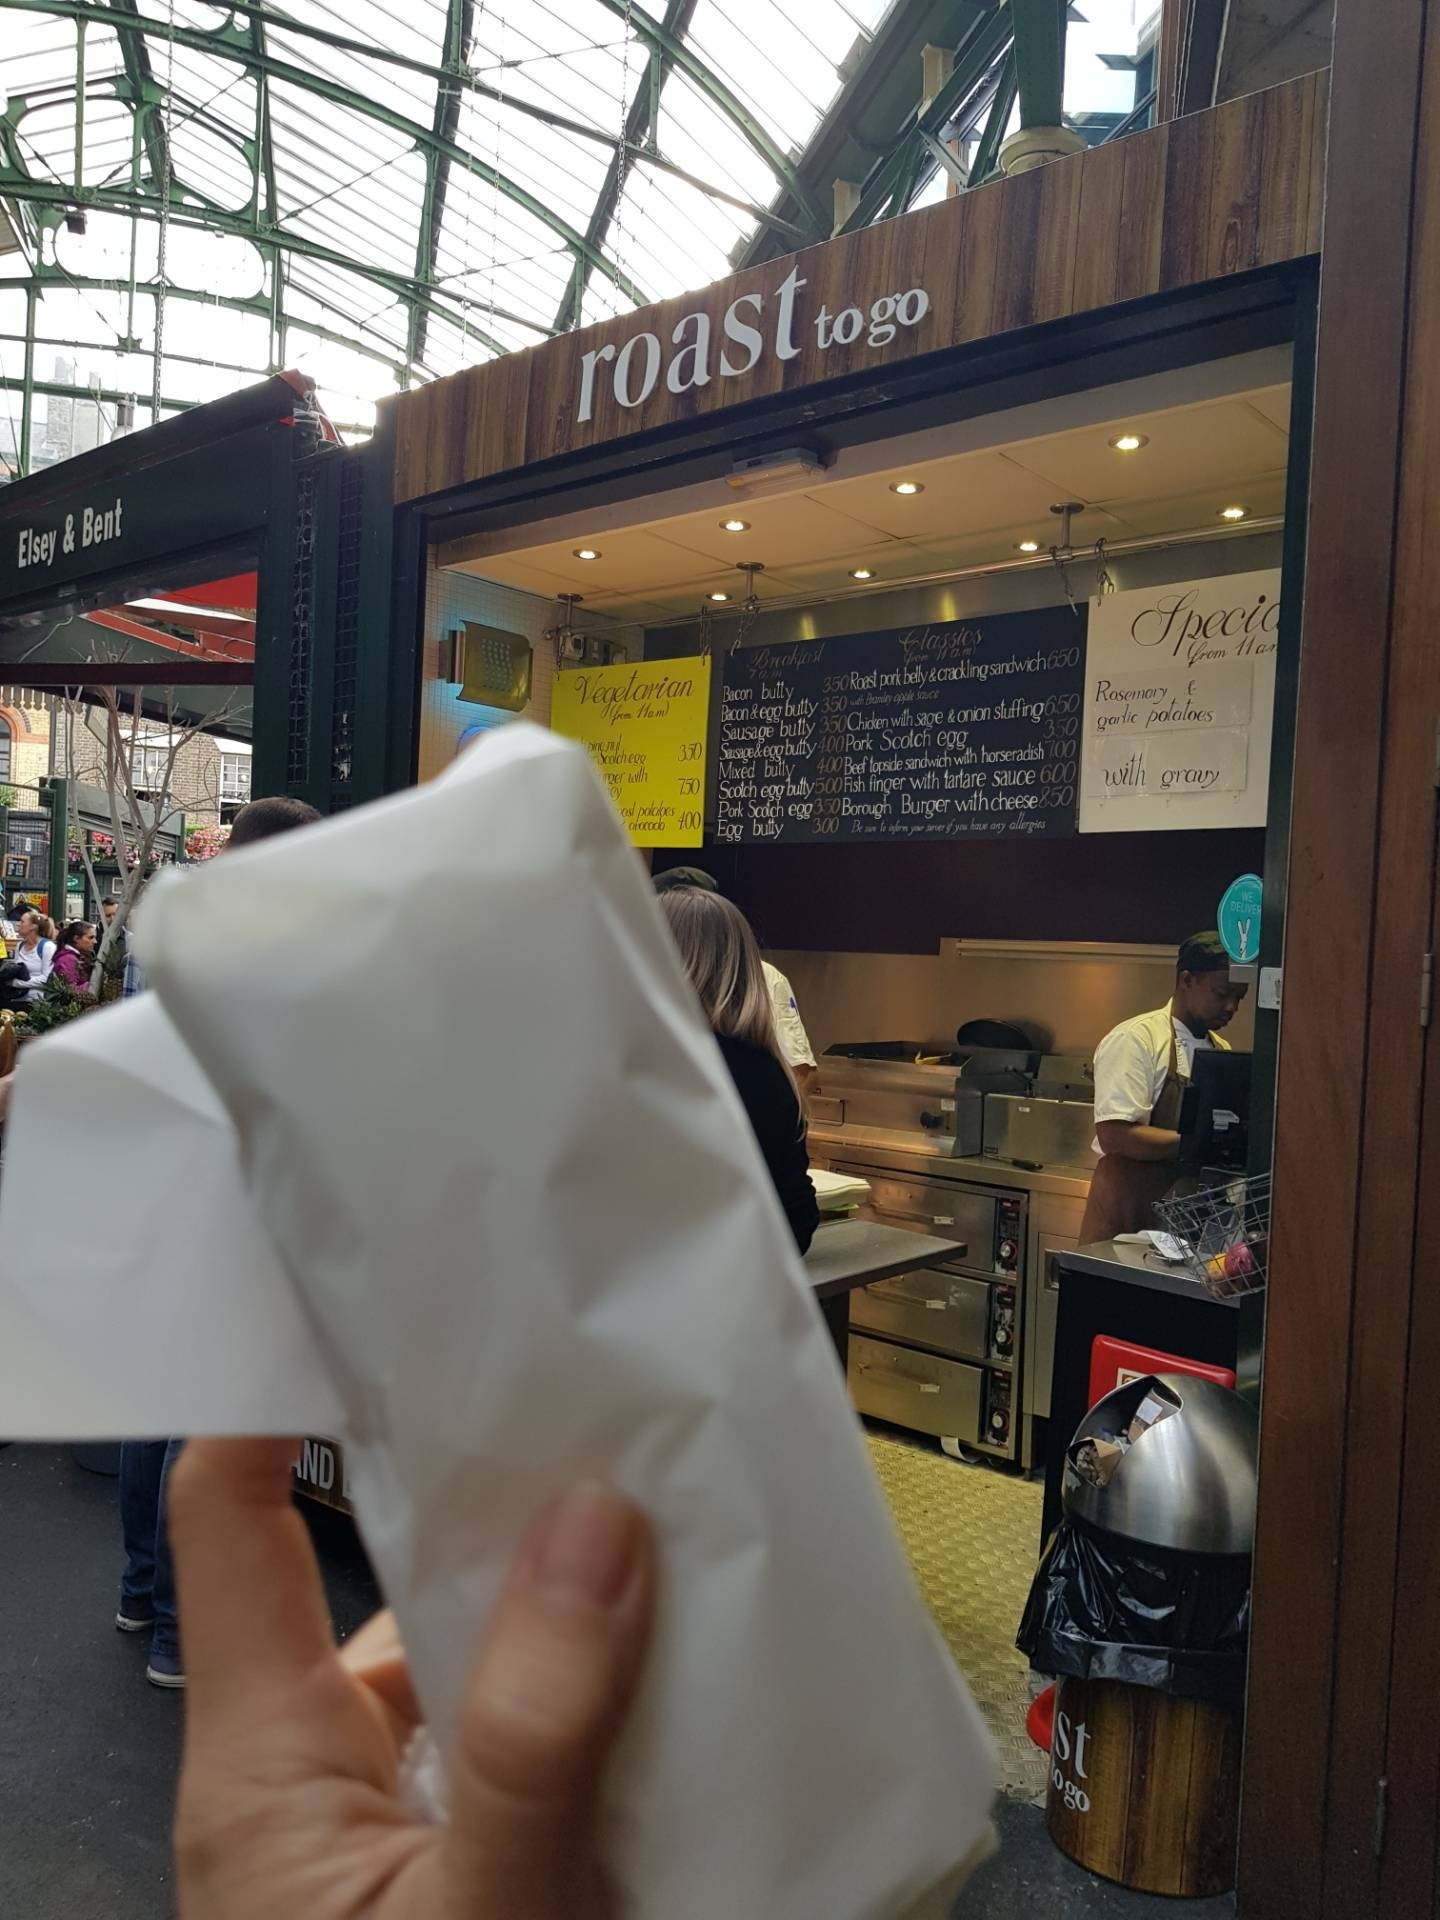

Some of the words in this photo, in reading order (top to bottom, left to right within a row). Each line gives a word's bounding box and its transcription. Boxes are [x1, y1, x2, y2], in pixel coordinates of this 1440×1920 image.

[577, 264, 807, 423] roast
[18, 527, 57, 568] Elsey
[63, 513, 75, 554] &
[82, 498, 122, 547] Bent
[899, 627, 982, 654] Classics
[752, 643, 826, 670] Breakfast
[850, 668, 877, 690] Roast
[880, 667, 901, 690] pork
[903, 664, 928, 688] belly
[929, 667, 936, 682] &
[938, 659, 988, 681] crackling
[989, 649, 1046, 675] sandwich
[575, 670, 692, 715] Vegetarian
[723, 686, 752, 702] Bacon
[762, 681, 794, 702] butty
[822, 674, 850, 693] 350
[1096, 680, 1168, 704] Rosemary
[721, 704, 748, 722] Bacon
[750, 704, 758, 719] &
[760, 705, 783, 723] egg
[785, 698, 819, 718] butty
[821, 696, 847, 713] 350
[847, 711, 888, 730] Chicken
[891, 708, 913, 726] with
[914, 711, 944, 728] sage
[947, 709, 956, 723] &
[957, 705, 991, 722] onion
[994, 698, 1045, 723] stuffing
[1097, 703, 1138, 732] garlic
[1145, 698, 1214, 728] potatoes
[722, 723, 774, 743] Sausage
[780, 718, 816, 739] butty
[846, 732, 873, 752] Pork
[880, 729, 931, 751] Scotch
[937, 730, 969, 751] egg
[678, 742, 702, 762] 350
[754, 743, 763, 757] &
[764, 744, 784, 761] egg
[785, 738, 817, 759] butty
[844, 755, 868, 775] Beef
[870, 754, 903, 774] topside
[905, 749, 951, 770] sandwich
[953, 746, 977, 764] with
[981, 741, 1045, 763] horseradish
[719, 761, 755, 779] Mixed
[764, 760, 795, 781] butty
[844, 776, 865, 792] Fish
[870, 774, 906, 796] finger
[909, 770, 940, 790] with
[944, 768, 987, 789] tartare
[991, 769, 1036, 787] sauce
[1103, 752, 1145, 786] with
[1160, 767, 1220, 789] gravy
[678, 777, 701, 795] 750
[719, 780, 757, 799] Scotch
[761, 785, 785, 801] egg
[787, 777, 815, 799] butty
[718, 801, 743, 817] Pork
[748, 800, 783, 818] Scotch
[788, 803, 813, 820] egg
[841, 794, 892, 819] Borough
[901, 793, 951, 819] Burger
[954, 790, 989, 811] with
[990, 791, 1038, 811] cheese
[718, 820, 743, 841] Egg
[753, 818, 784, 840] butty
[1064, 1781, 1090, 1812] go
